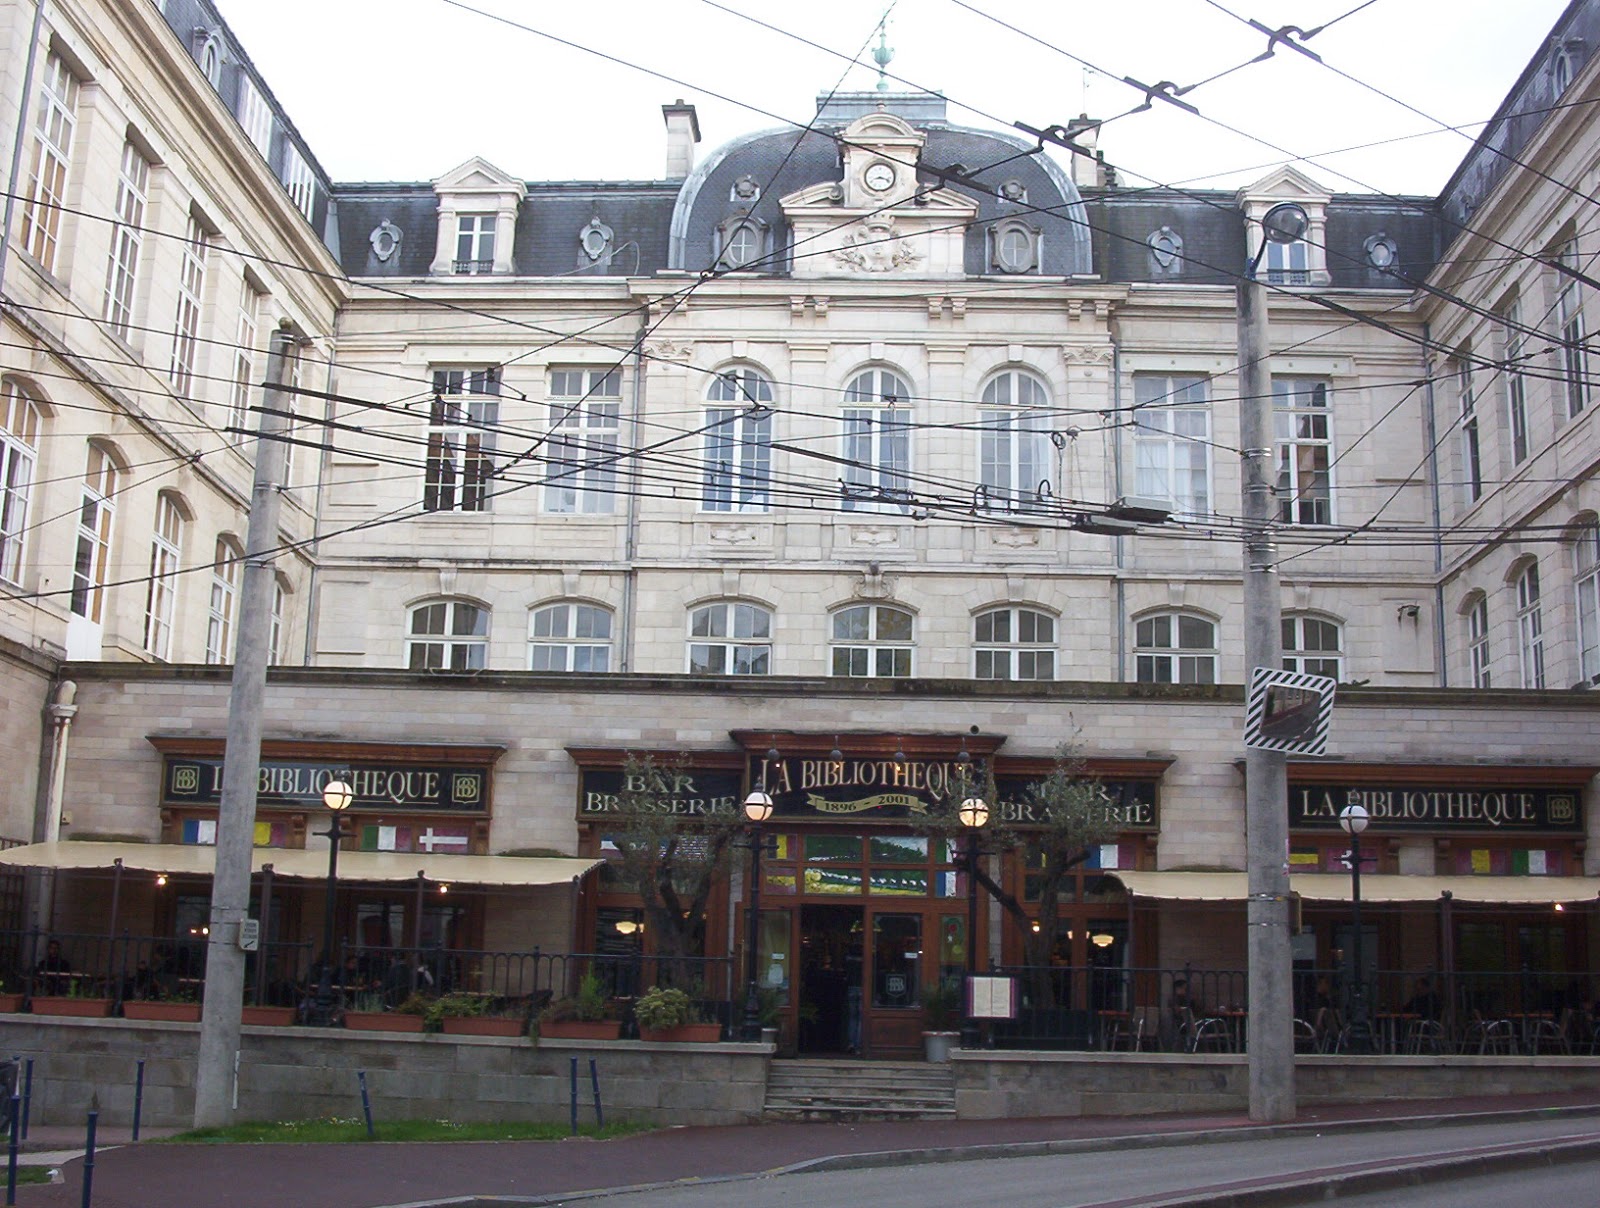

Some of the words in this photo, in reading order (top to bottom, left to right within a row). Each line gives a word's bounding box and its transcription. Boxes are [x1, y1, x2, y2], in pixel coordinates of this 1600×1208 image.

[257, 766, 439, 804] BIBLIOHEQUE
[626, 774, 698, 793] BAR
[761, 759, 792, 796] LA
[801, 760, 974, 801] BIBLIOTHEQUE
[824, 802, 857, 812] 1896
[878, 795, 910, 805] 2001
[1302, 790, 1336, 816] LA
